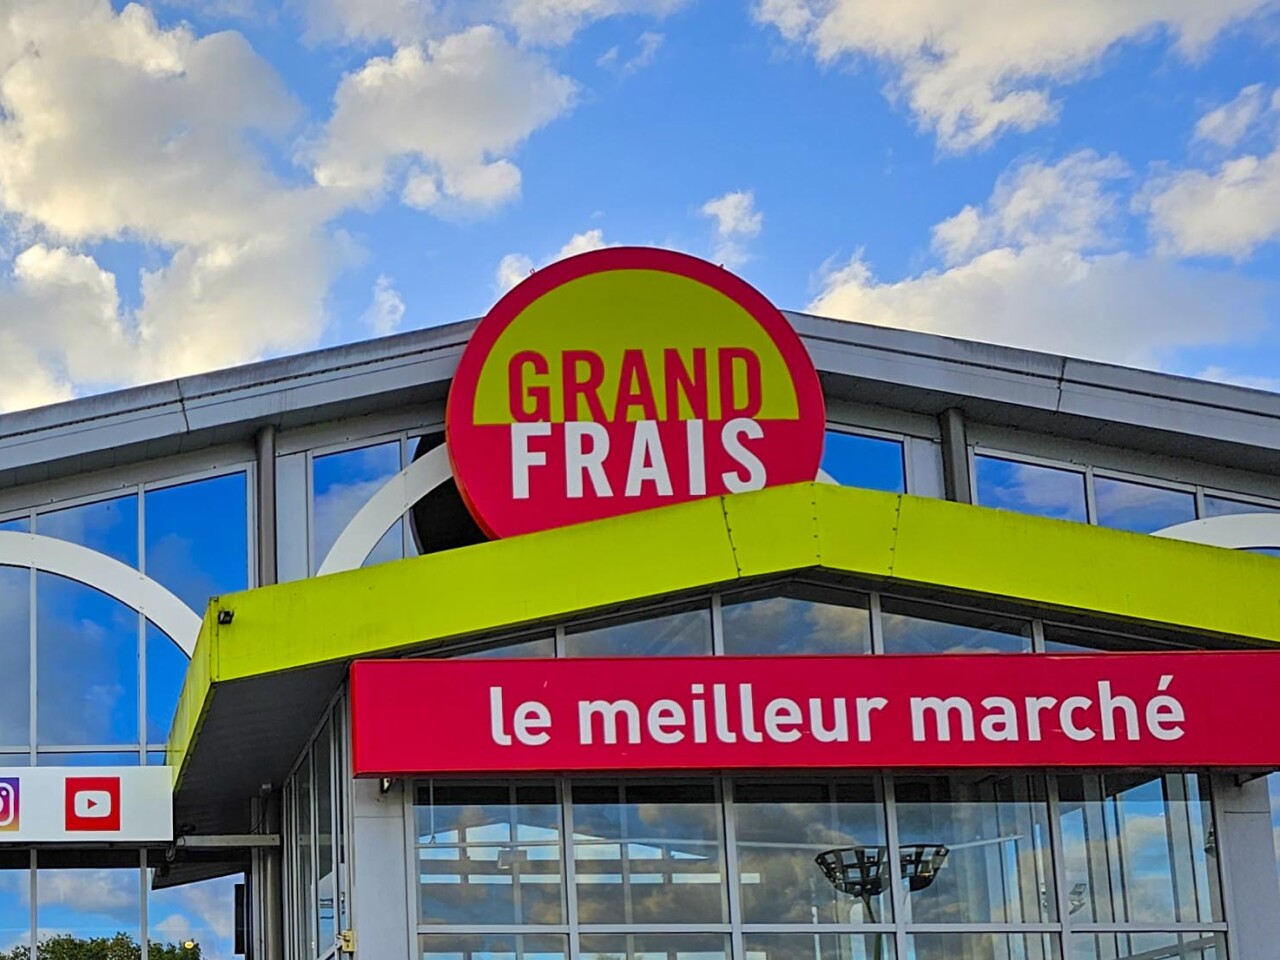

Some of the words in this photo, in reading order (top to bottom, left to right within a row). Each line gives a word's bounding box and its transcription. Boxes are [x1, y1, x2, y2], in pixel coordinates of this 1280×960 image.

[508, 347, 763, 422] GRAND
[510, 418, 767, 499] FRAIS
[489, 686, 551, 745] le
[578, 683, 888, 744] meilleur
[911, 675, 1186, 742] marché
